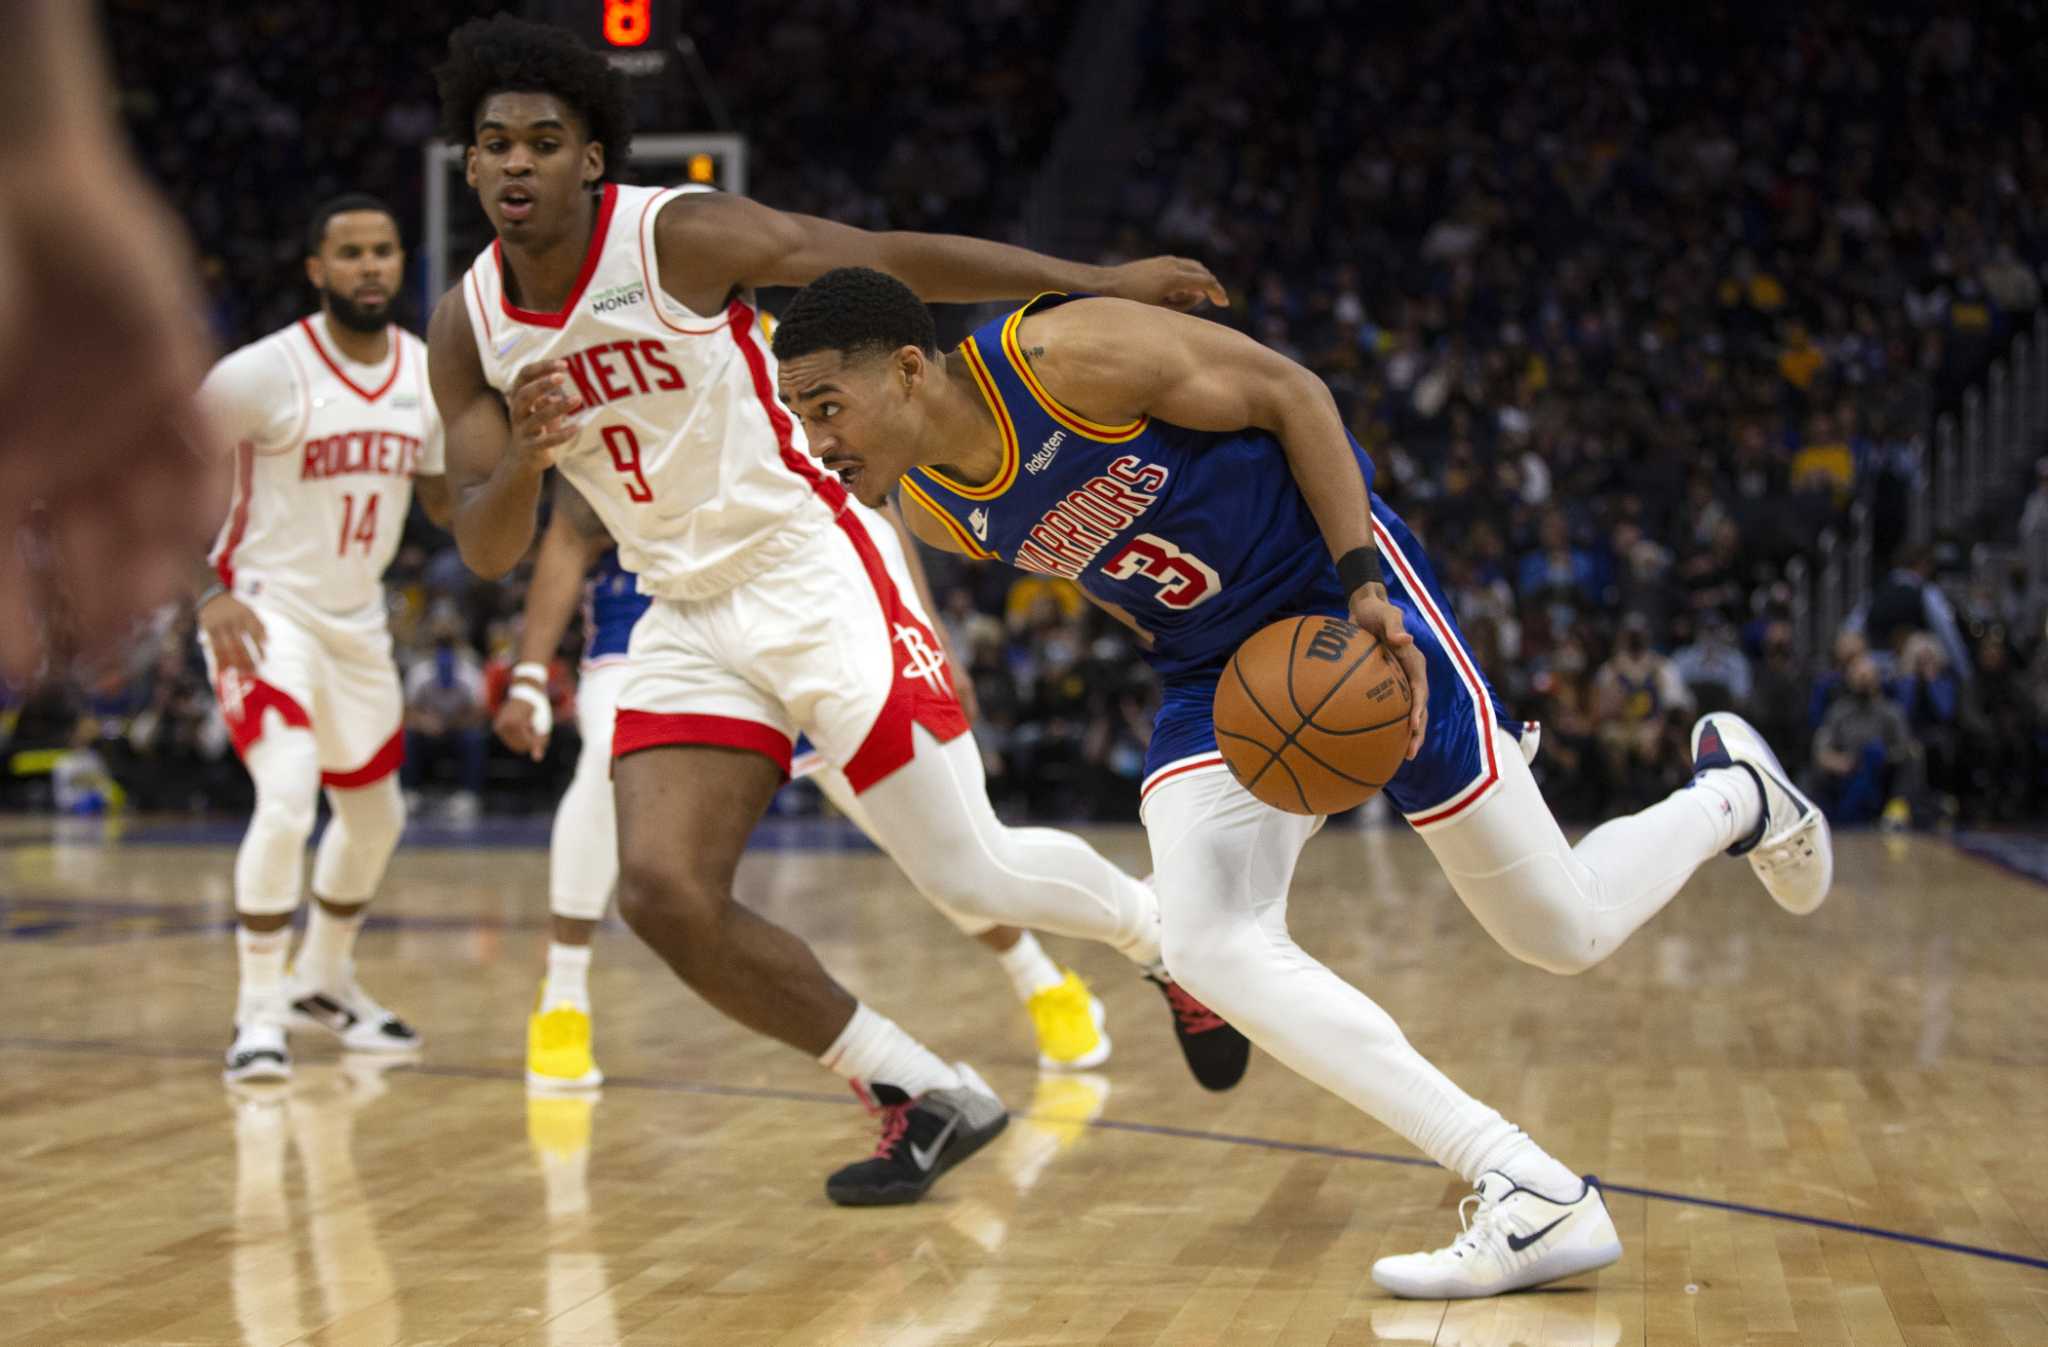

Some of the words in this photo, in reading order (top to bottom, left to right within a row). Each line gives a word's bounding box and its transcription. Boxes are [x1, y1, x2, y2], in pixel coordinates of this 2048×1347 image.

[592, 289, 645, 314] MONEY
[563, 339, 686, 416] KETS
[601, 424, 653, 503] 9
[1024, 430, 1067, 475] Rakuten
[338, 493, 379, 558] 14
[1100, 533, 1222, 610] 3
